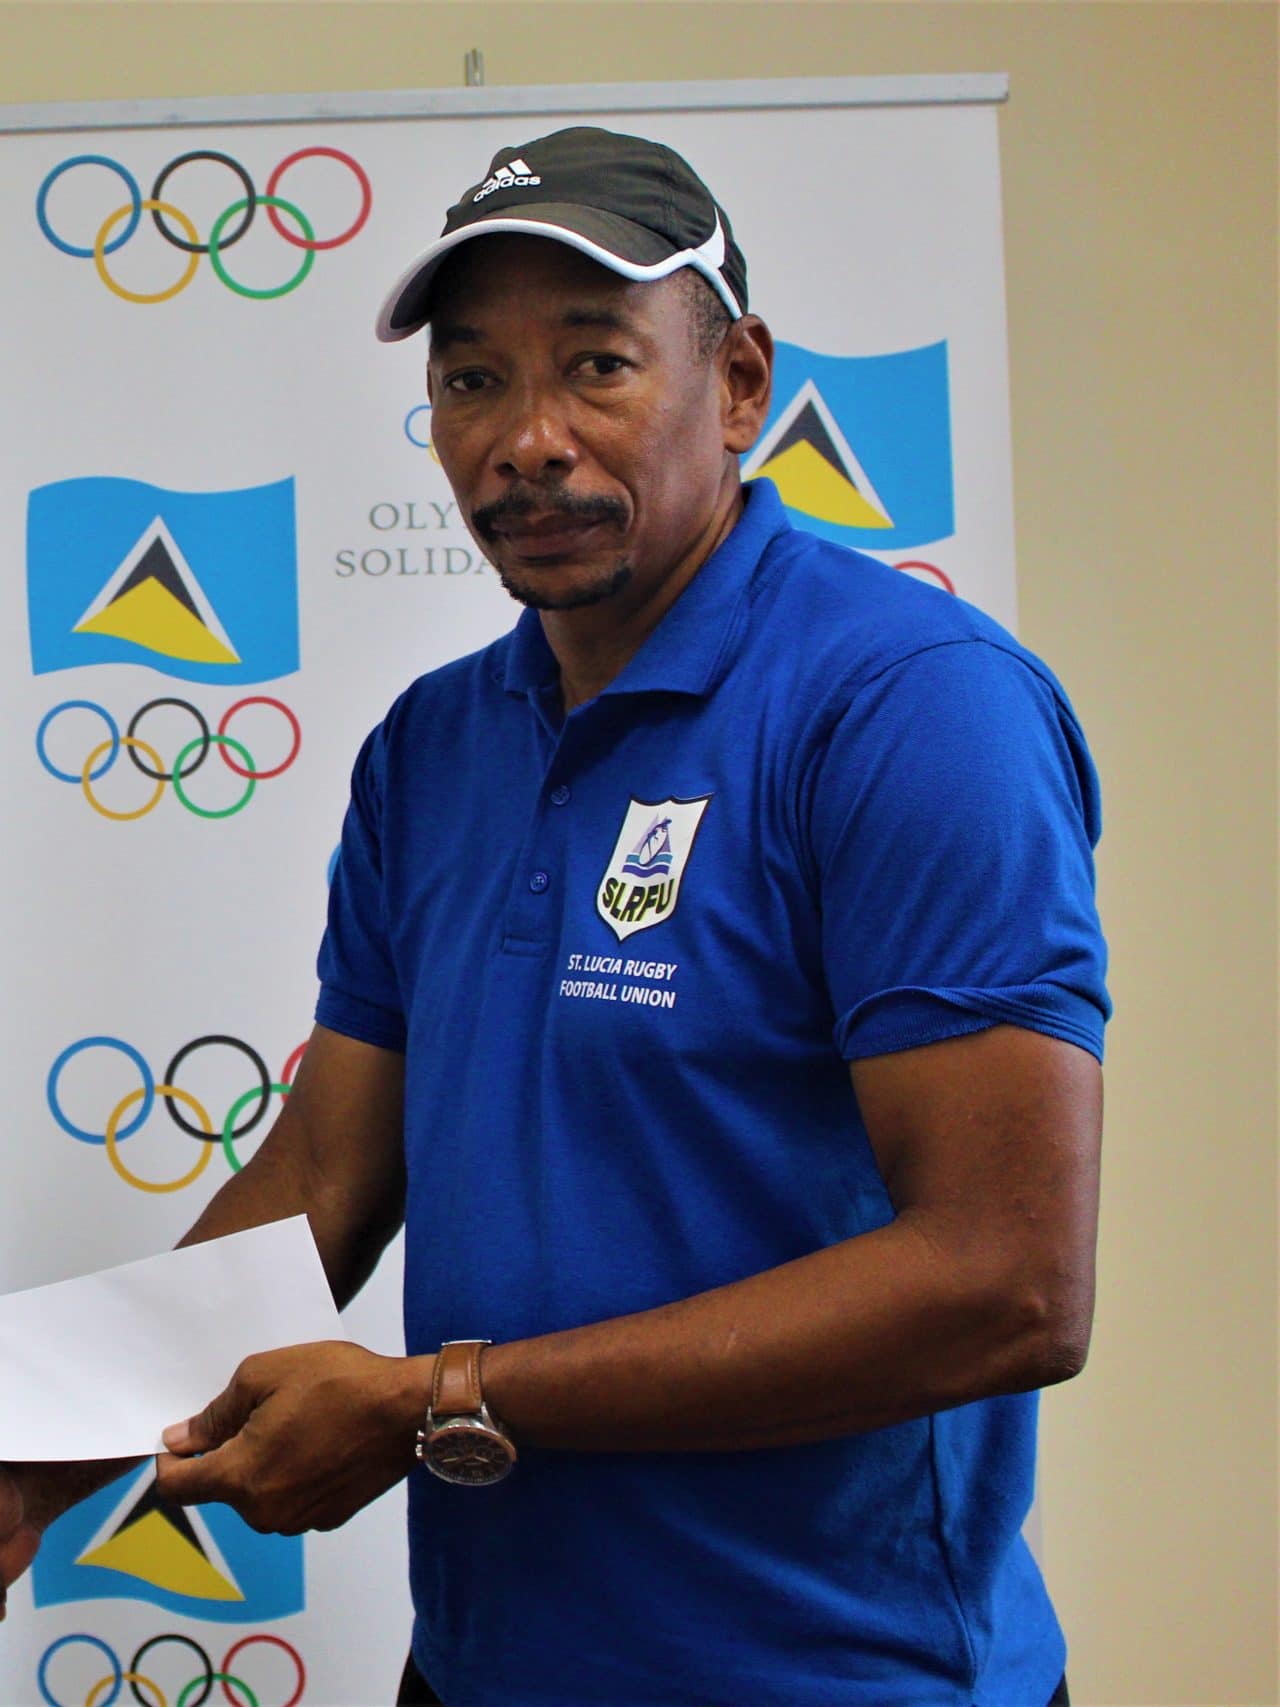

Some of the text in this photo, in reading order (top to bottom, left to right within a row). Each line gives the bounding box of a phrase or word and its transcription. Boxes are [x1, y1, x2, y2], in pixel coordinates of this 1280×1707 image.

[473, 174, 541, 203] adidas
[602, 877, 675, 922] SLRFU
[567, 954, 678, 981] ST. LUCIA RUGBY
[560, 980, 676, 1009] FOOTBALL UNION
